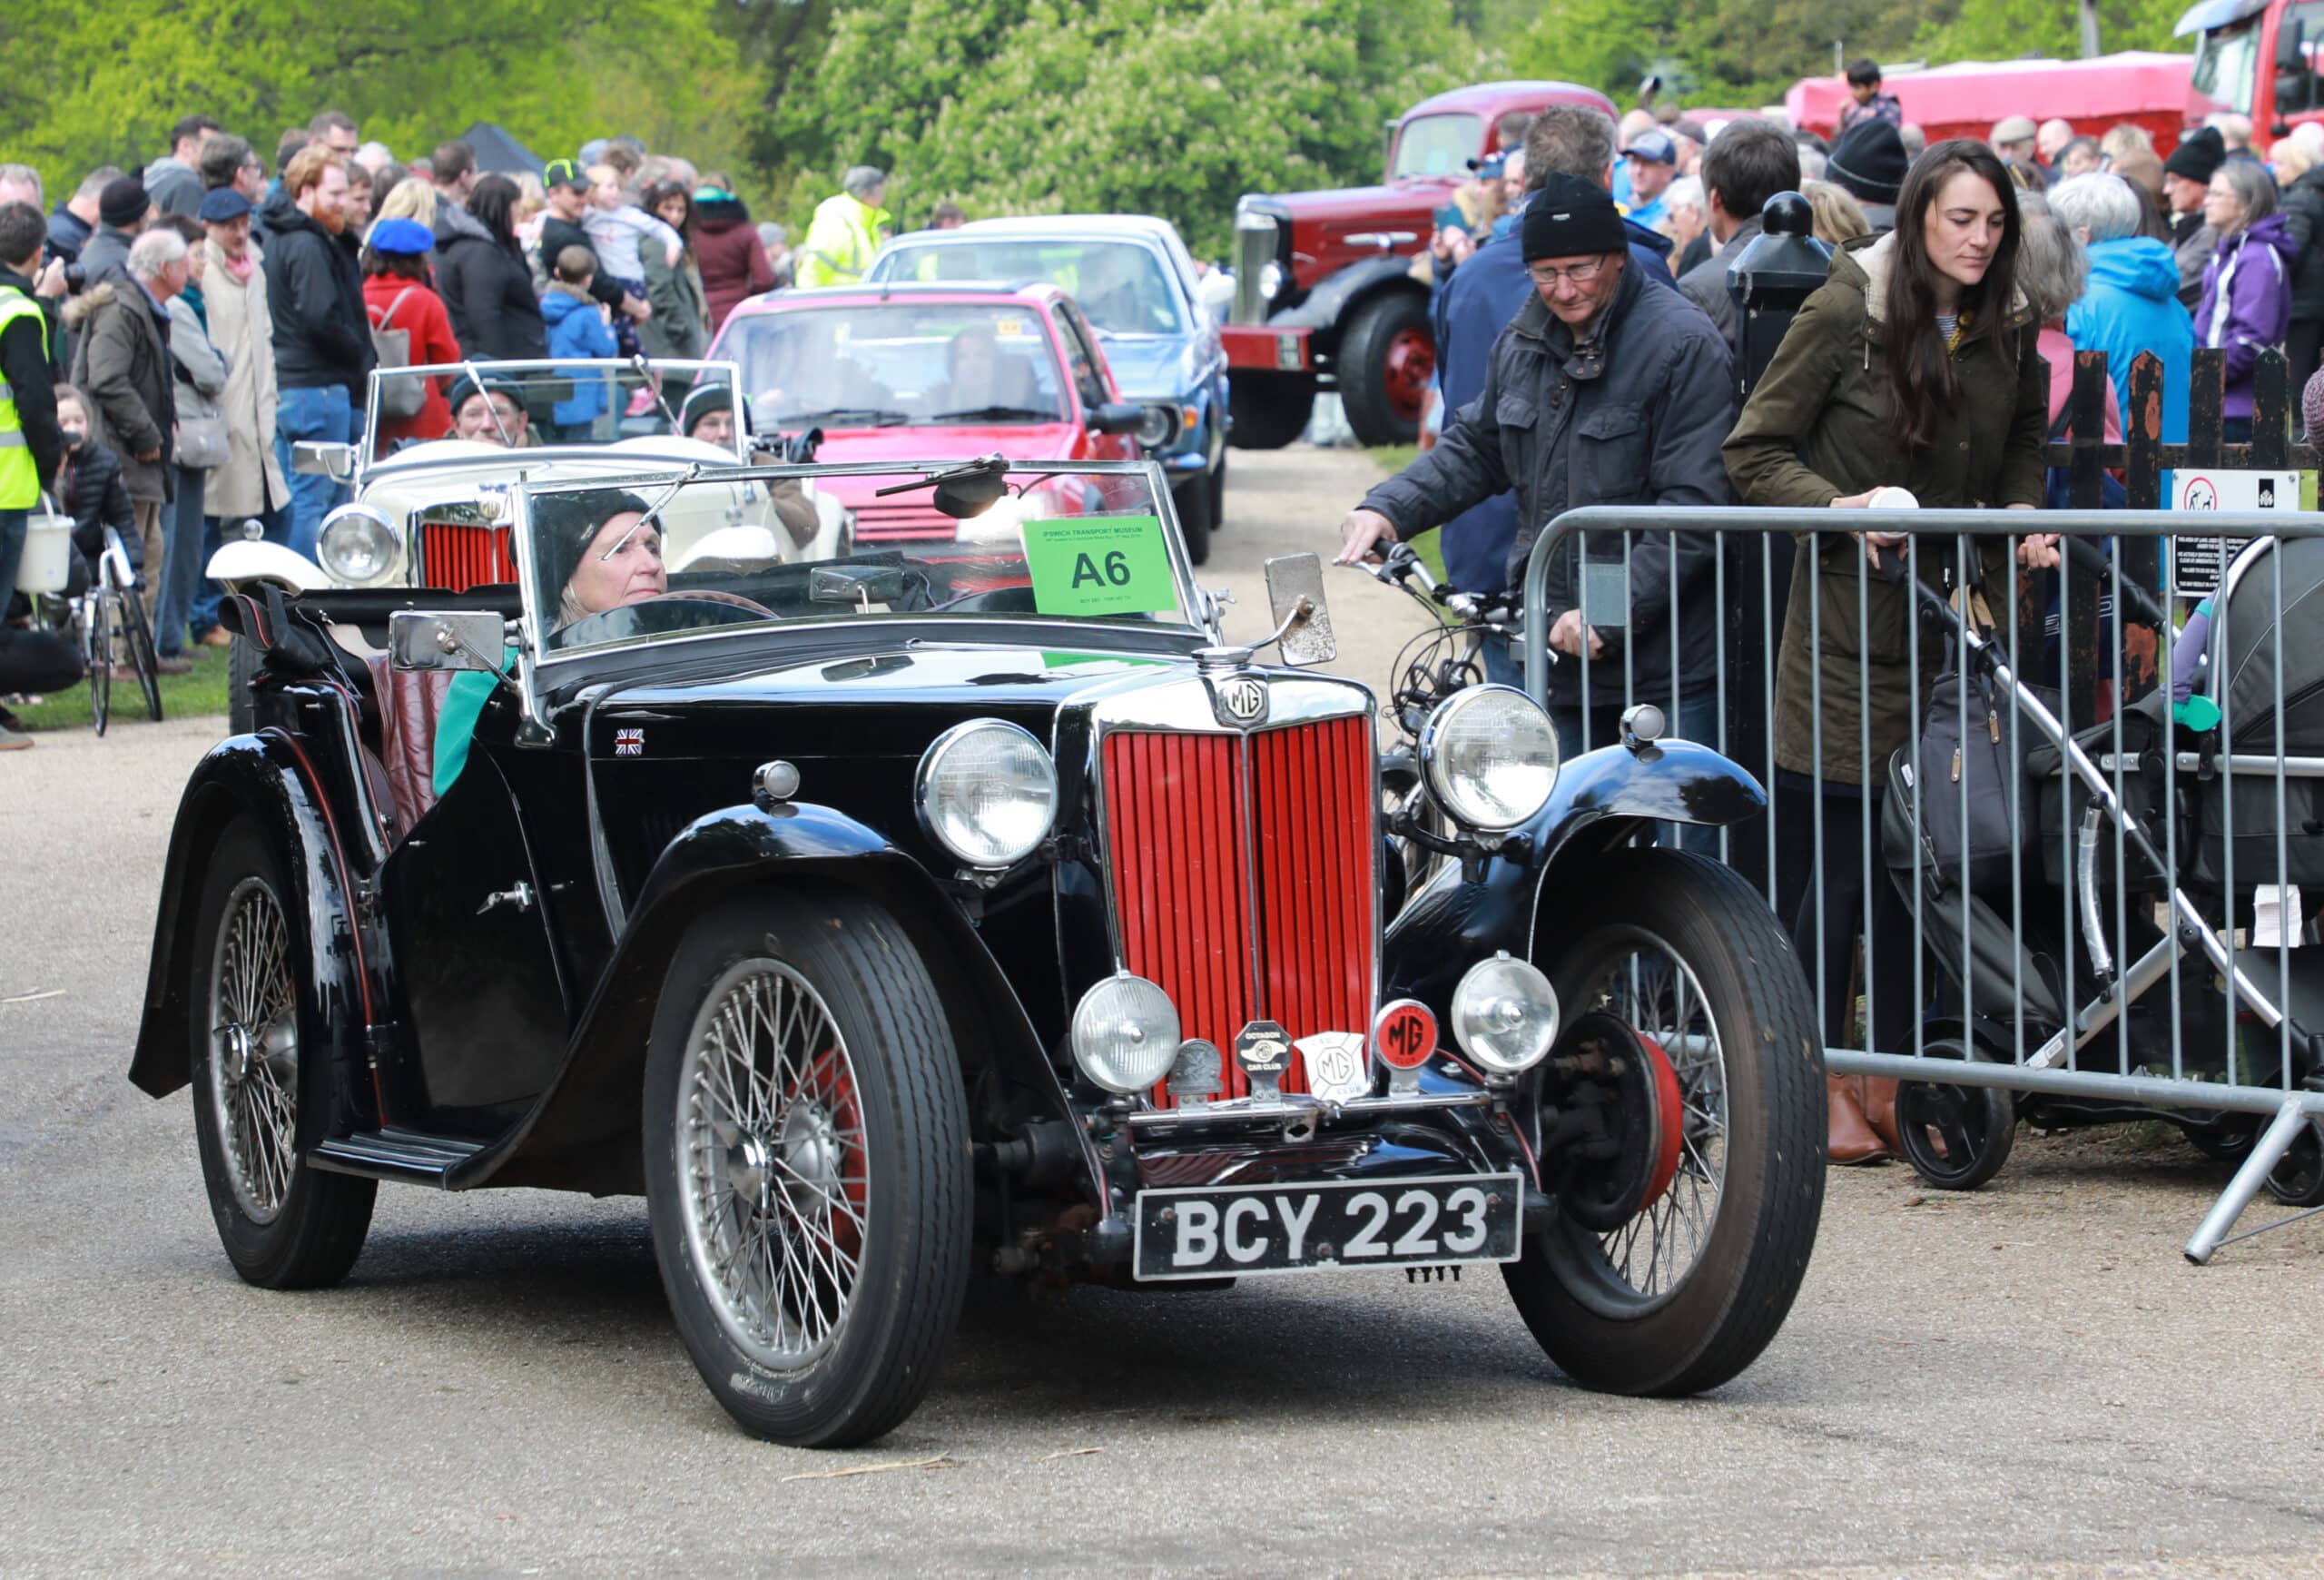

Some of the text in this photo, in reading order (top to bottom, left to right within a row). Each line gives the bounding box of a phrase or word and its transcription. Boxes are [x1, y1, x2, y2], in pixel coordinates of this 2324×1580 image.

[1072, 528, 1112, 536] TRANSPORT
[1071, 550, 1131, 589] A6
[1232, 684, 1259, 714] MG
[1245, 1032, 1281, 1040] OCTAGON
[1388, 1015, 1423, 1055] MG
[1263, 1062, 1283, 1071] CLUB
[1322, 1052, 1351, 1081] MG
[1172, 1187, 1489, 1267] BCY 223
